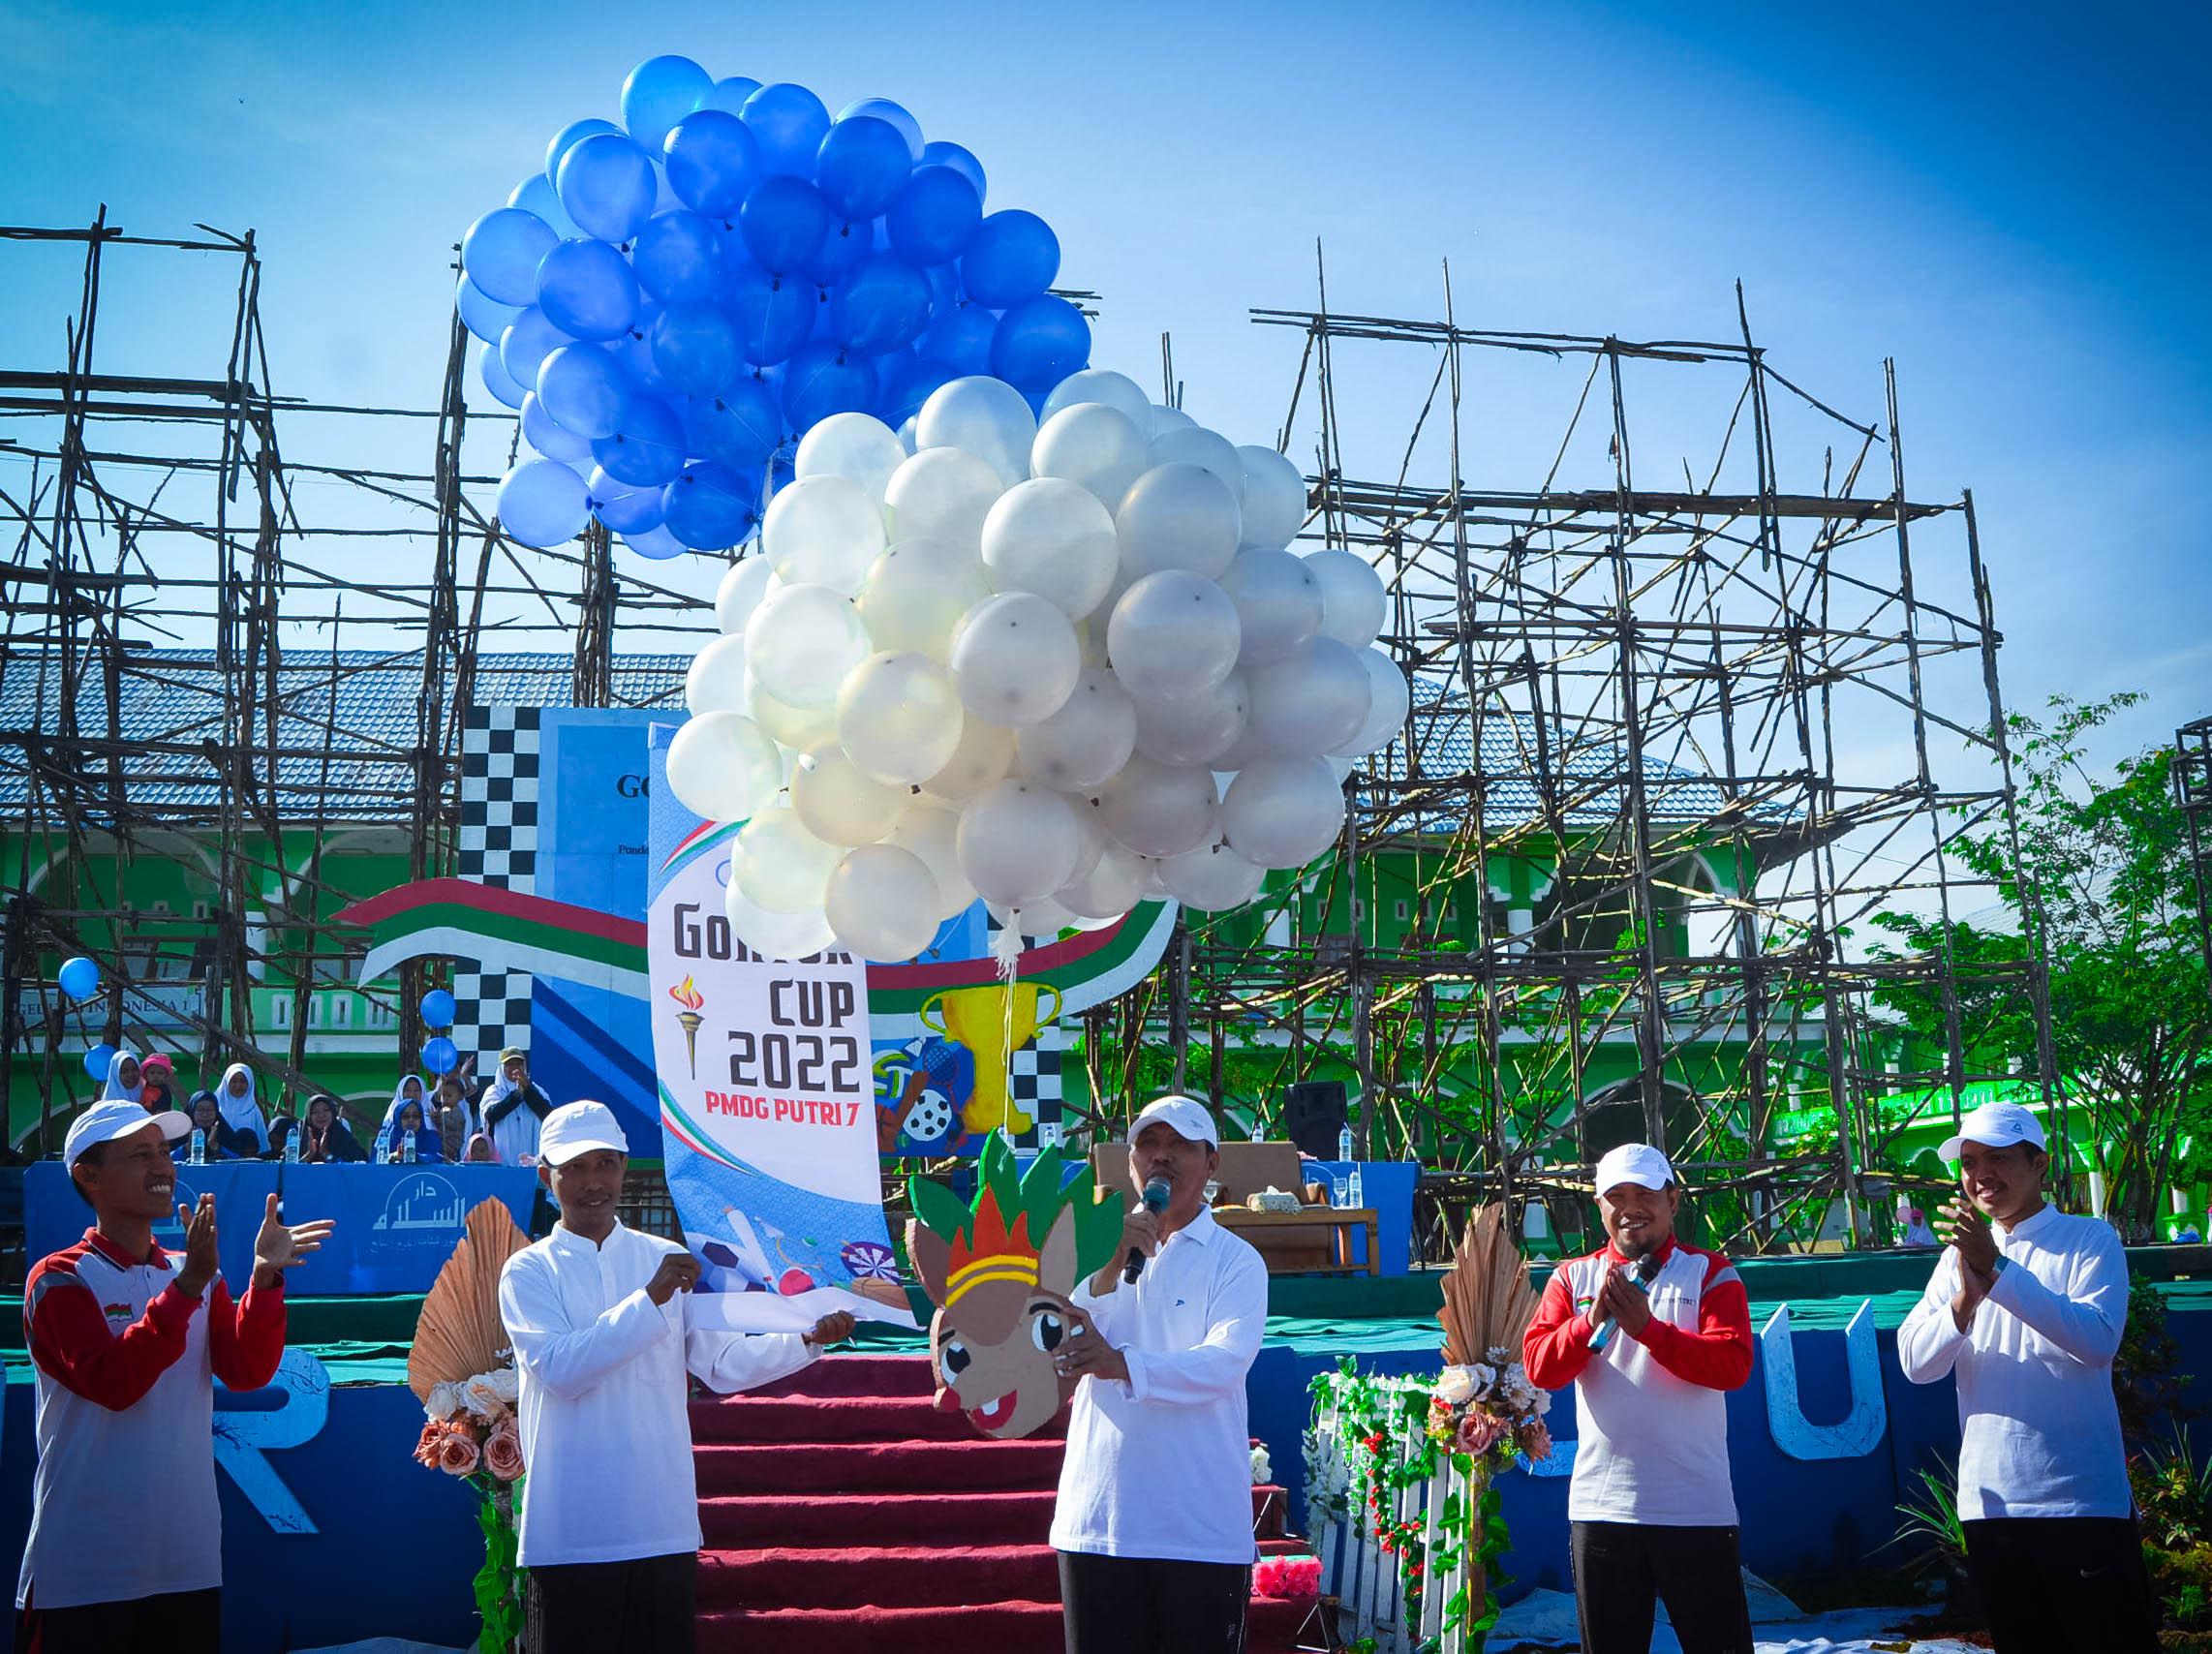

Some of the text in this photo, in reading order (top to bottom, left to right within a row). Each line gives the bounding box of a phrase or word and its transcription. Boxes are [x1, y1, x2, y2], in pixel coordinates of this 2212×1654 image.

[770, 977, 855, 1028] CUP
[728, 1030, 861, 1093] 2022
[705, 1090, 861, 1126] PMDG PUTRI 7
[414, 1180, 437, 1202] دار
[1760, 1298, 1887, 1460] U
